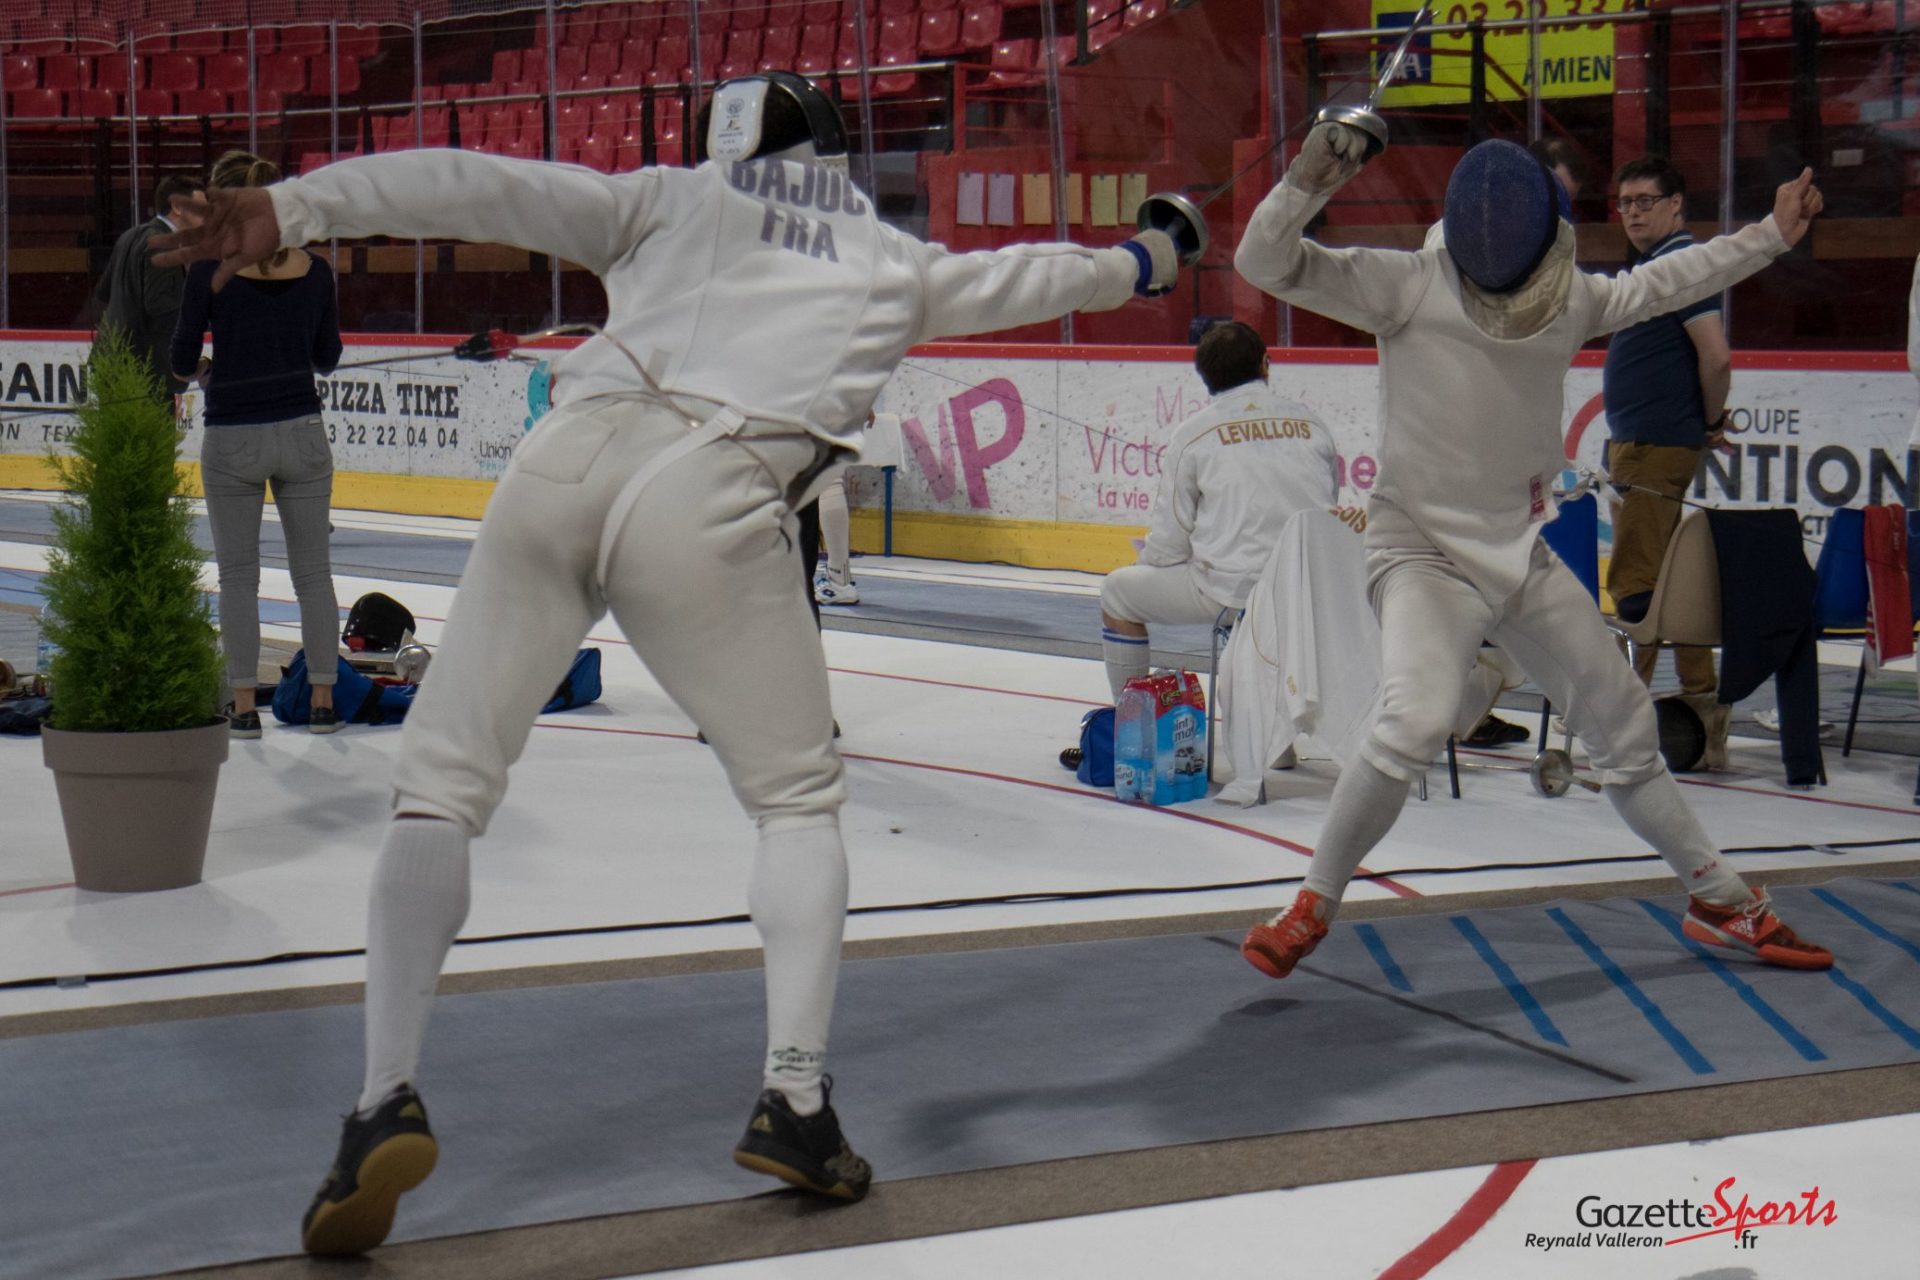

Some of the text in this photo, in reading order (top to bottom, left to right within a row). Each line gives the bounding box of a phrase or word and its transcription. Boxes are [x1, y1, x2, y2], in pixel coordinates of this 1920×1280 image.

[760, 204, 839, 263] FRA
[0, 362, 88, 404] AIN
[317, 381, 460, 420] PIZZA TIME
[347, 424, 367, 445] 22
[377, 424, 397, 446] 22
[407, 427, 428, 449] 04
[437, 428, 459, 450] 04
[1217, 421, 1312, 446] LEVALLOIS
[1097, 487, 1150, 510] la vie
